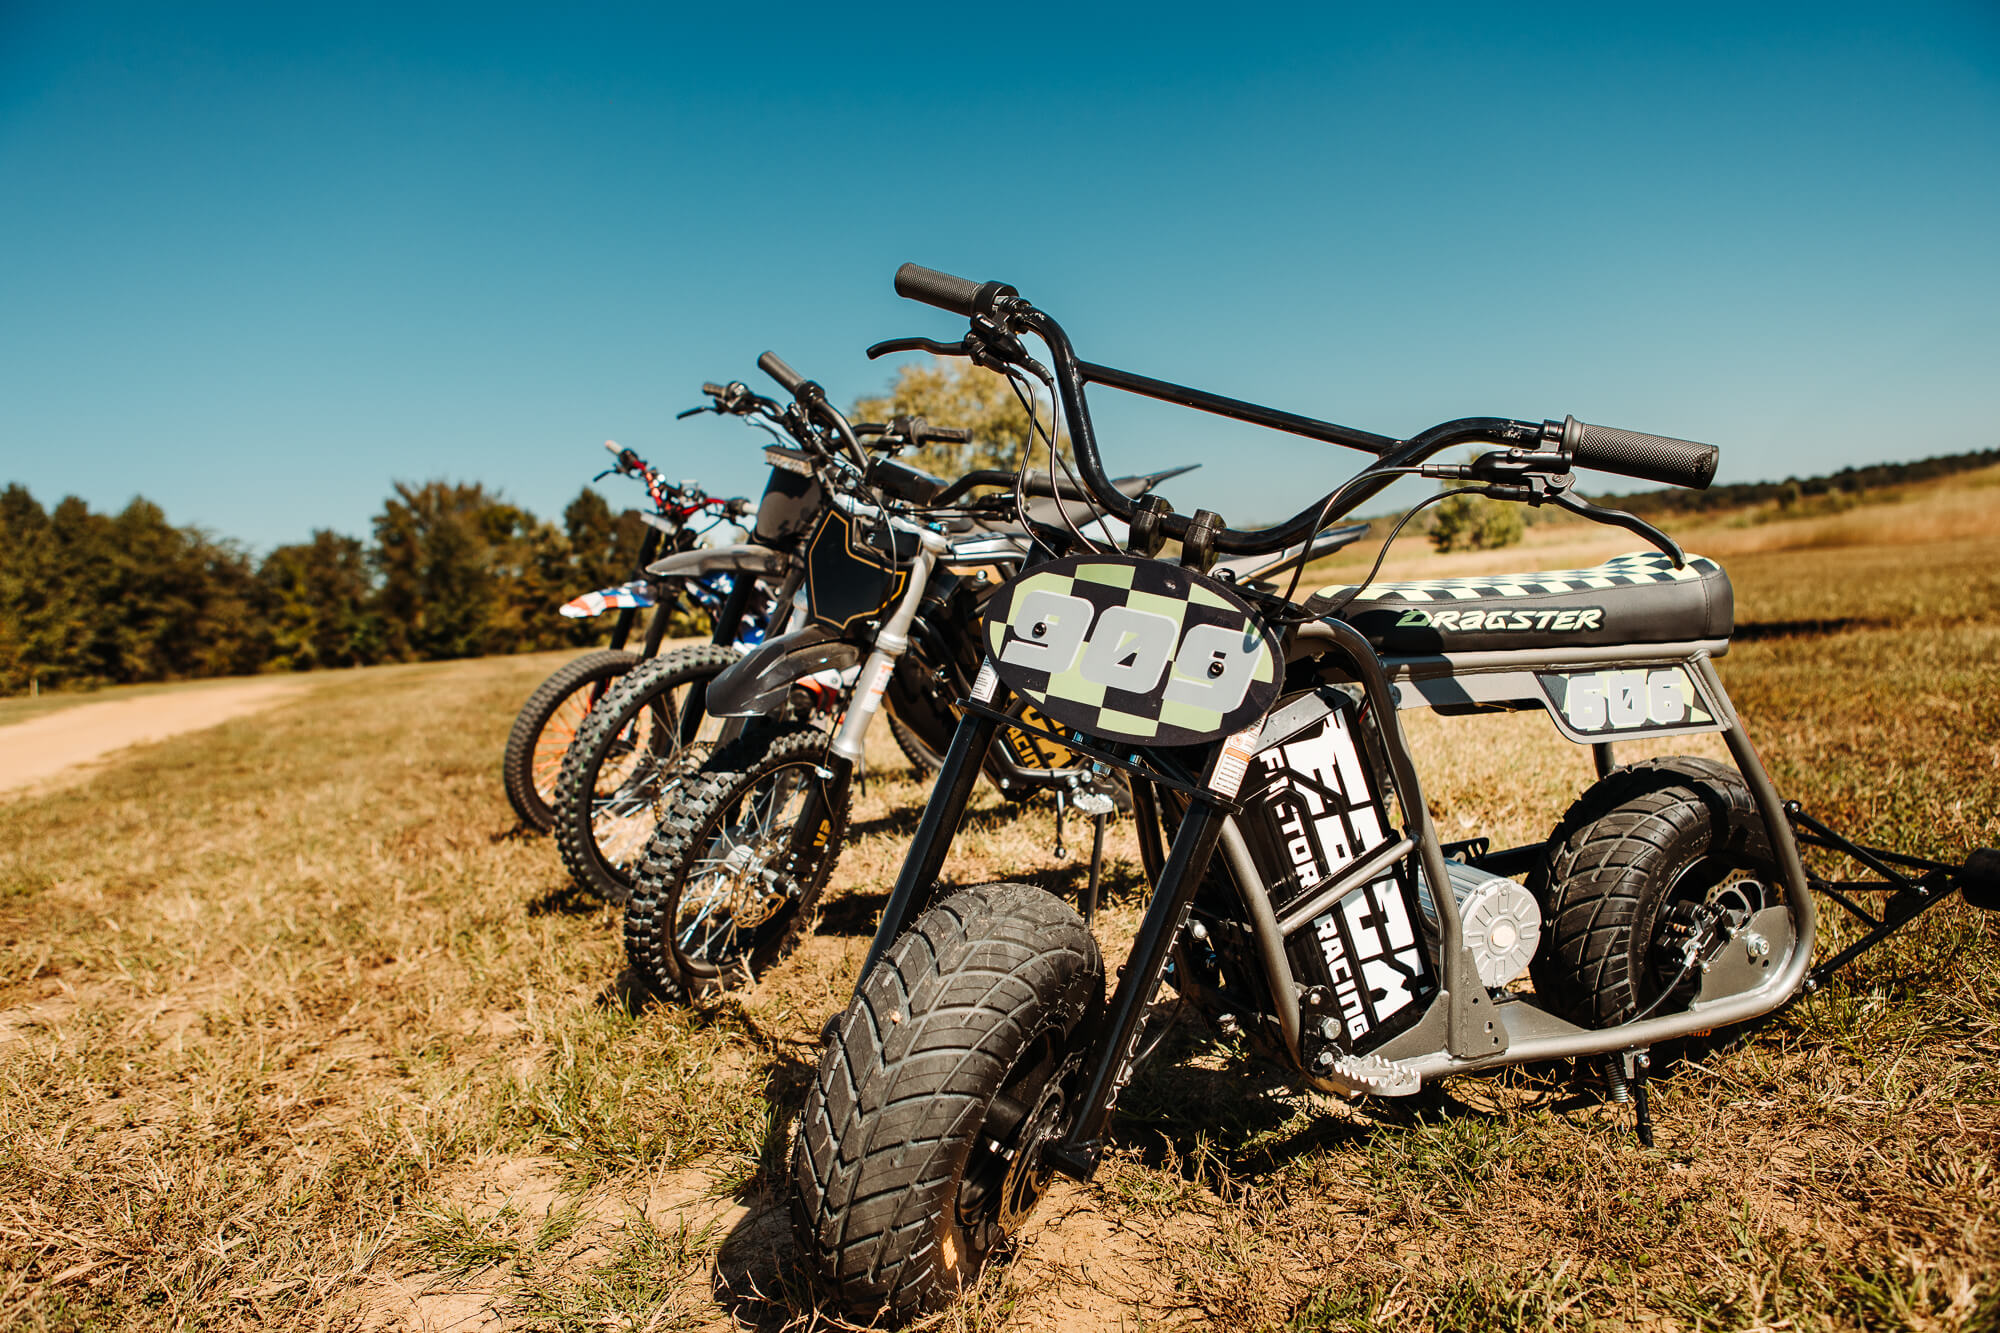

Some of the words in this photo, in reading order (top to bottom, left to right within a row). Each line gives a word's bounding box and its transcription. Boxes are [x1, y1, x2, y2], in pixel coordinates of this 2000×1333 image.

[1000, 590, 1263, 713] 909
[1568, 670, 1685, 730] 606
[1259, 747, 1321, 890] FACTOR
[1313, 912, 1371, 1041] RACING
